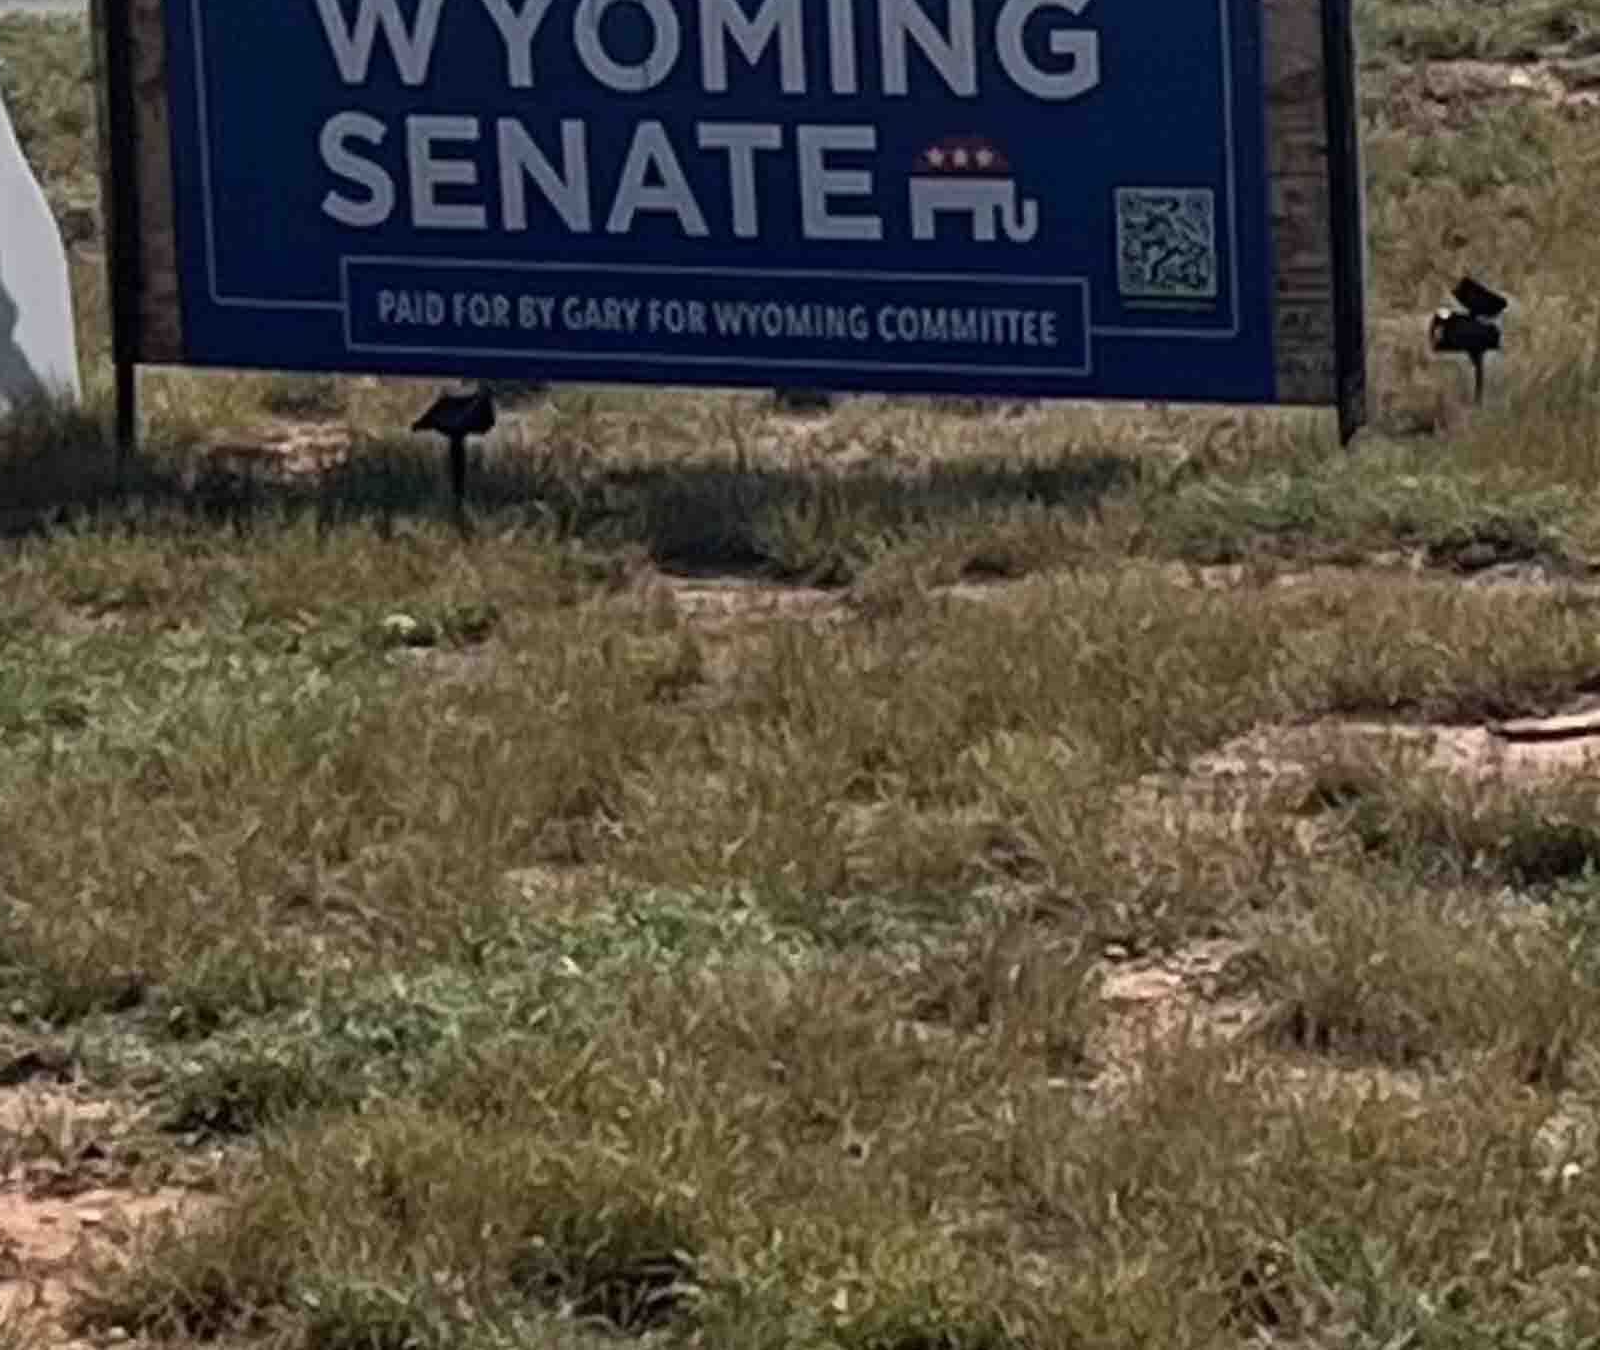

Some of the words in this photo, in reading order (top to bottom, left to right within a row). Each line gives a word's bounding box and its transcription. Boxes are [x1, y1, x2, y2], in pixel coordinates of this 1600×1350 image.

[319, 113, 883, 241] SENATE
[377, 290, 442, 325] PAID
[453, 293, 510, 328] FOR
[518, 295, 555, 329] BY
[561, 296, 642, 332] GARY
[648, 299, 708, 335] FOR
[712, 301, 870, 340] WYOMING
[876, 305, 1058, 346] COMMITTEE
